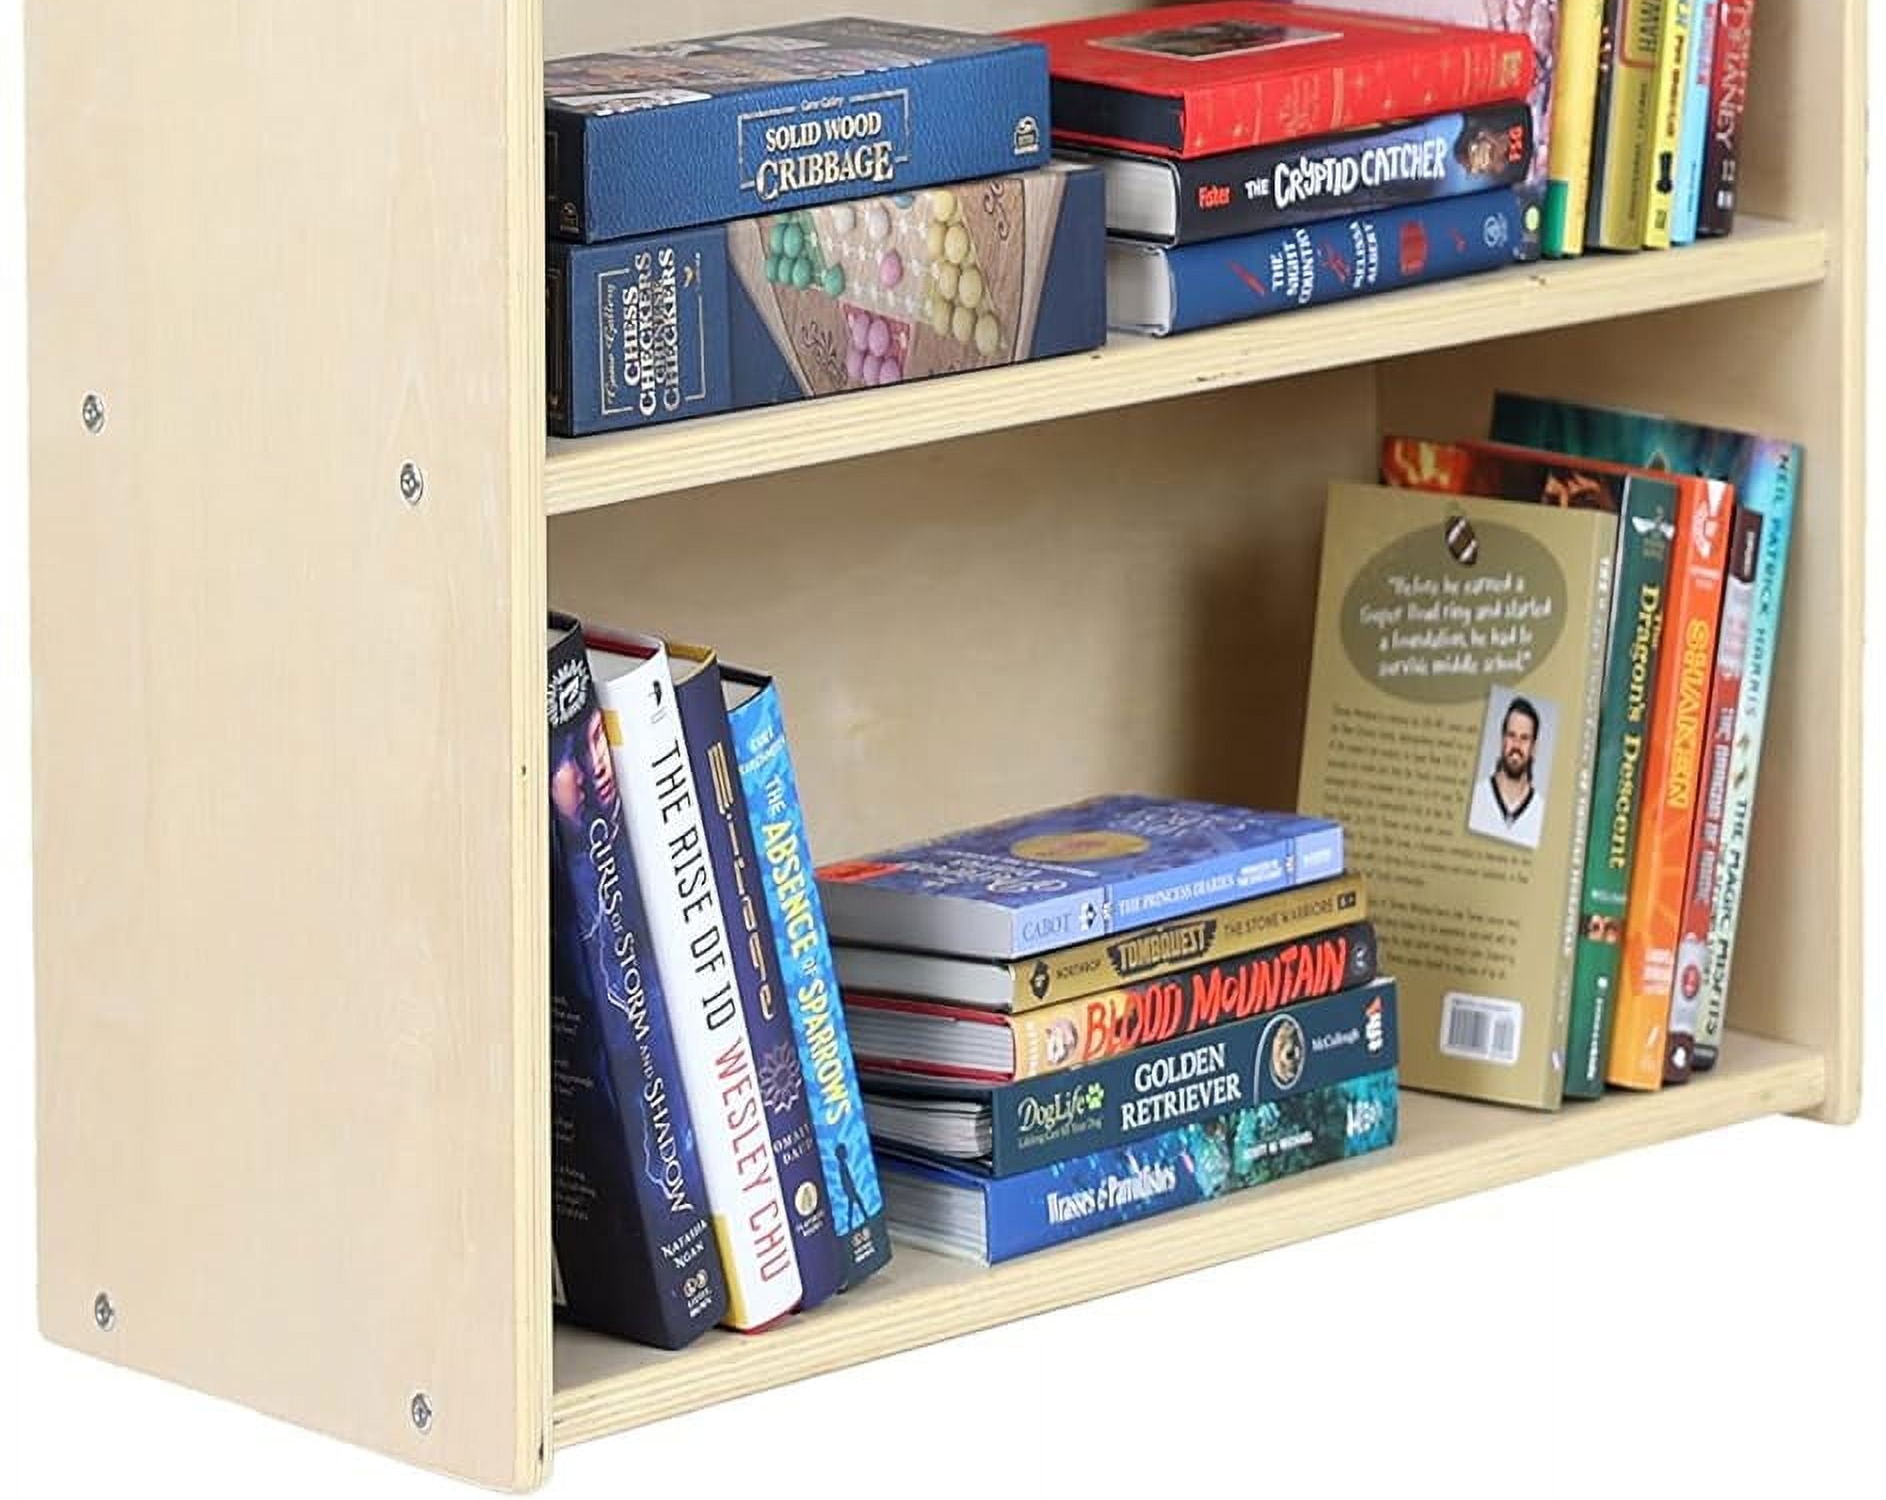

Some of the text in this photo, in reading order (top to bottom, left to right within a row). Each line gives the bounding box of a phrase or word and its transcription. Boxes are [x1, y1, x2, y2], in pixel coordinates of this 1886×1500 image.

[764, 110, 883, 153] SOLID WOOD
[754, 140, 895, 202] CRIBBAGE
[1244, 136, 1449, 210] THE CRYPTID CATCHER
[1269, 250, 1285, 293] THE
[1282, 239, 1300, 297] NIGHT
[1295, 227, 1314, 305] COUNTRY
[1349, 220, 1367, 289] MELISSA
[1362, 220, 1379, 285] ALBERT
[622, 284, 641, 387] CHESS
[634, 250, 657, 417] CHECKERS
[658, 247, 680, 412] CHECKERS
[1744, 454, 1790, 719] NEIL PATRICK HARRIS
[1627, 585, 1661, 724] Dragon's
[1666, 617, 1711, 811] SHAKEN
[650, 738, 693, 826] THE
[765, 773, 787, 820] THE
[1608, 731, 1643, 870] Descent
[589, 816, 625, 916] GIRLS
[666, 825, 716, 926] RISE
[761, 819, 815, 959] ABSENCE
[1720, 849, 1742, 933] MAGIC
[690, 923, 727, 975] OF
[1021, 913, 1072, 942] CABOT
[1119, 922, 1207, 973] TOMBQUEST
[1248, 913, 1280, 934] STONE
[613, 930, 651, 1043] STORM
[1081, 981, 1182, 1062] BLOOD
[1187, 935, 1351, 1034] MOUNTAIN
[638, 1043, 656, 1077] AND
[798, 981, 851, 1127] SPARROWS
[1134, 1043, 1227, 1092] GOLDEN
[714, 1036, 776, 1195] WESLEY
[1017, 1084, 1086, 1132] DogLife
[1120, 1072, 1242, 1132] RETRIEVER
[643, 1076, 694, 1215] SHADOW
[661, 1219, 708, 1259] NATASHA
[672, 1240, 706, 1269] NGAN
[747, 1197, 792, 1284] CHU
